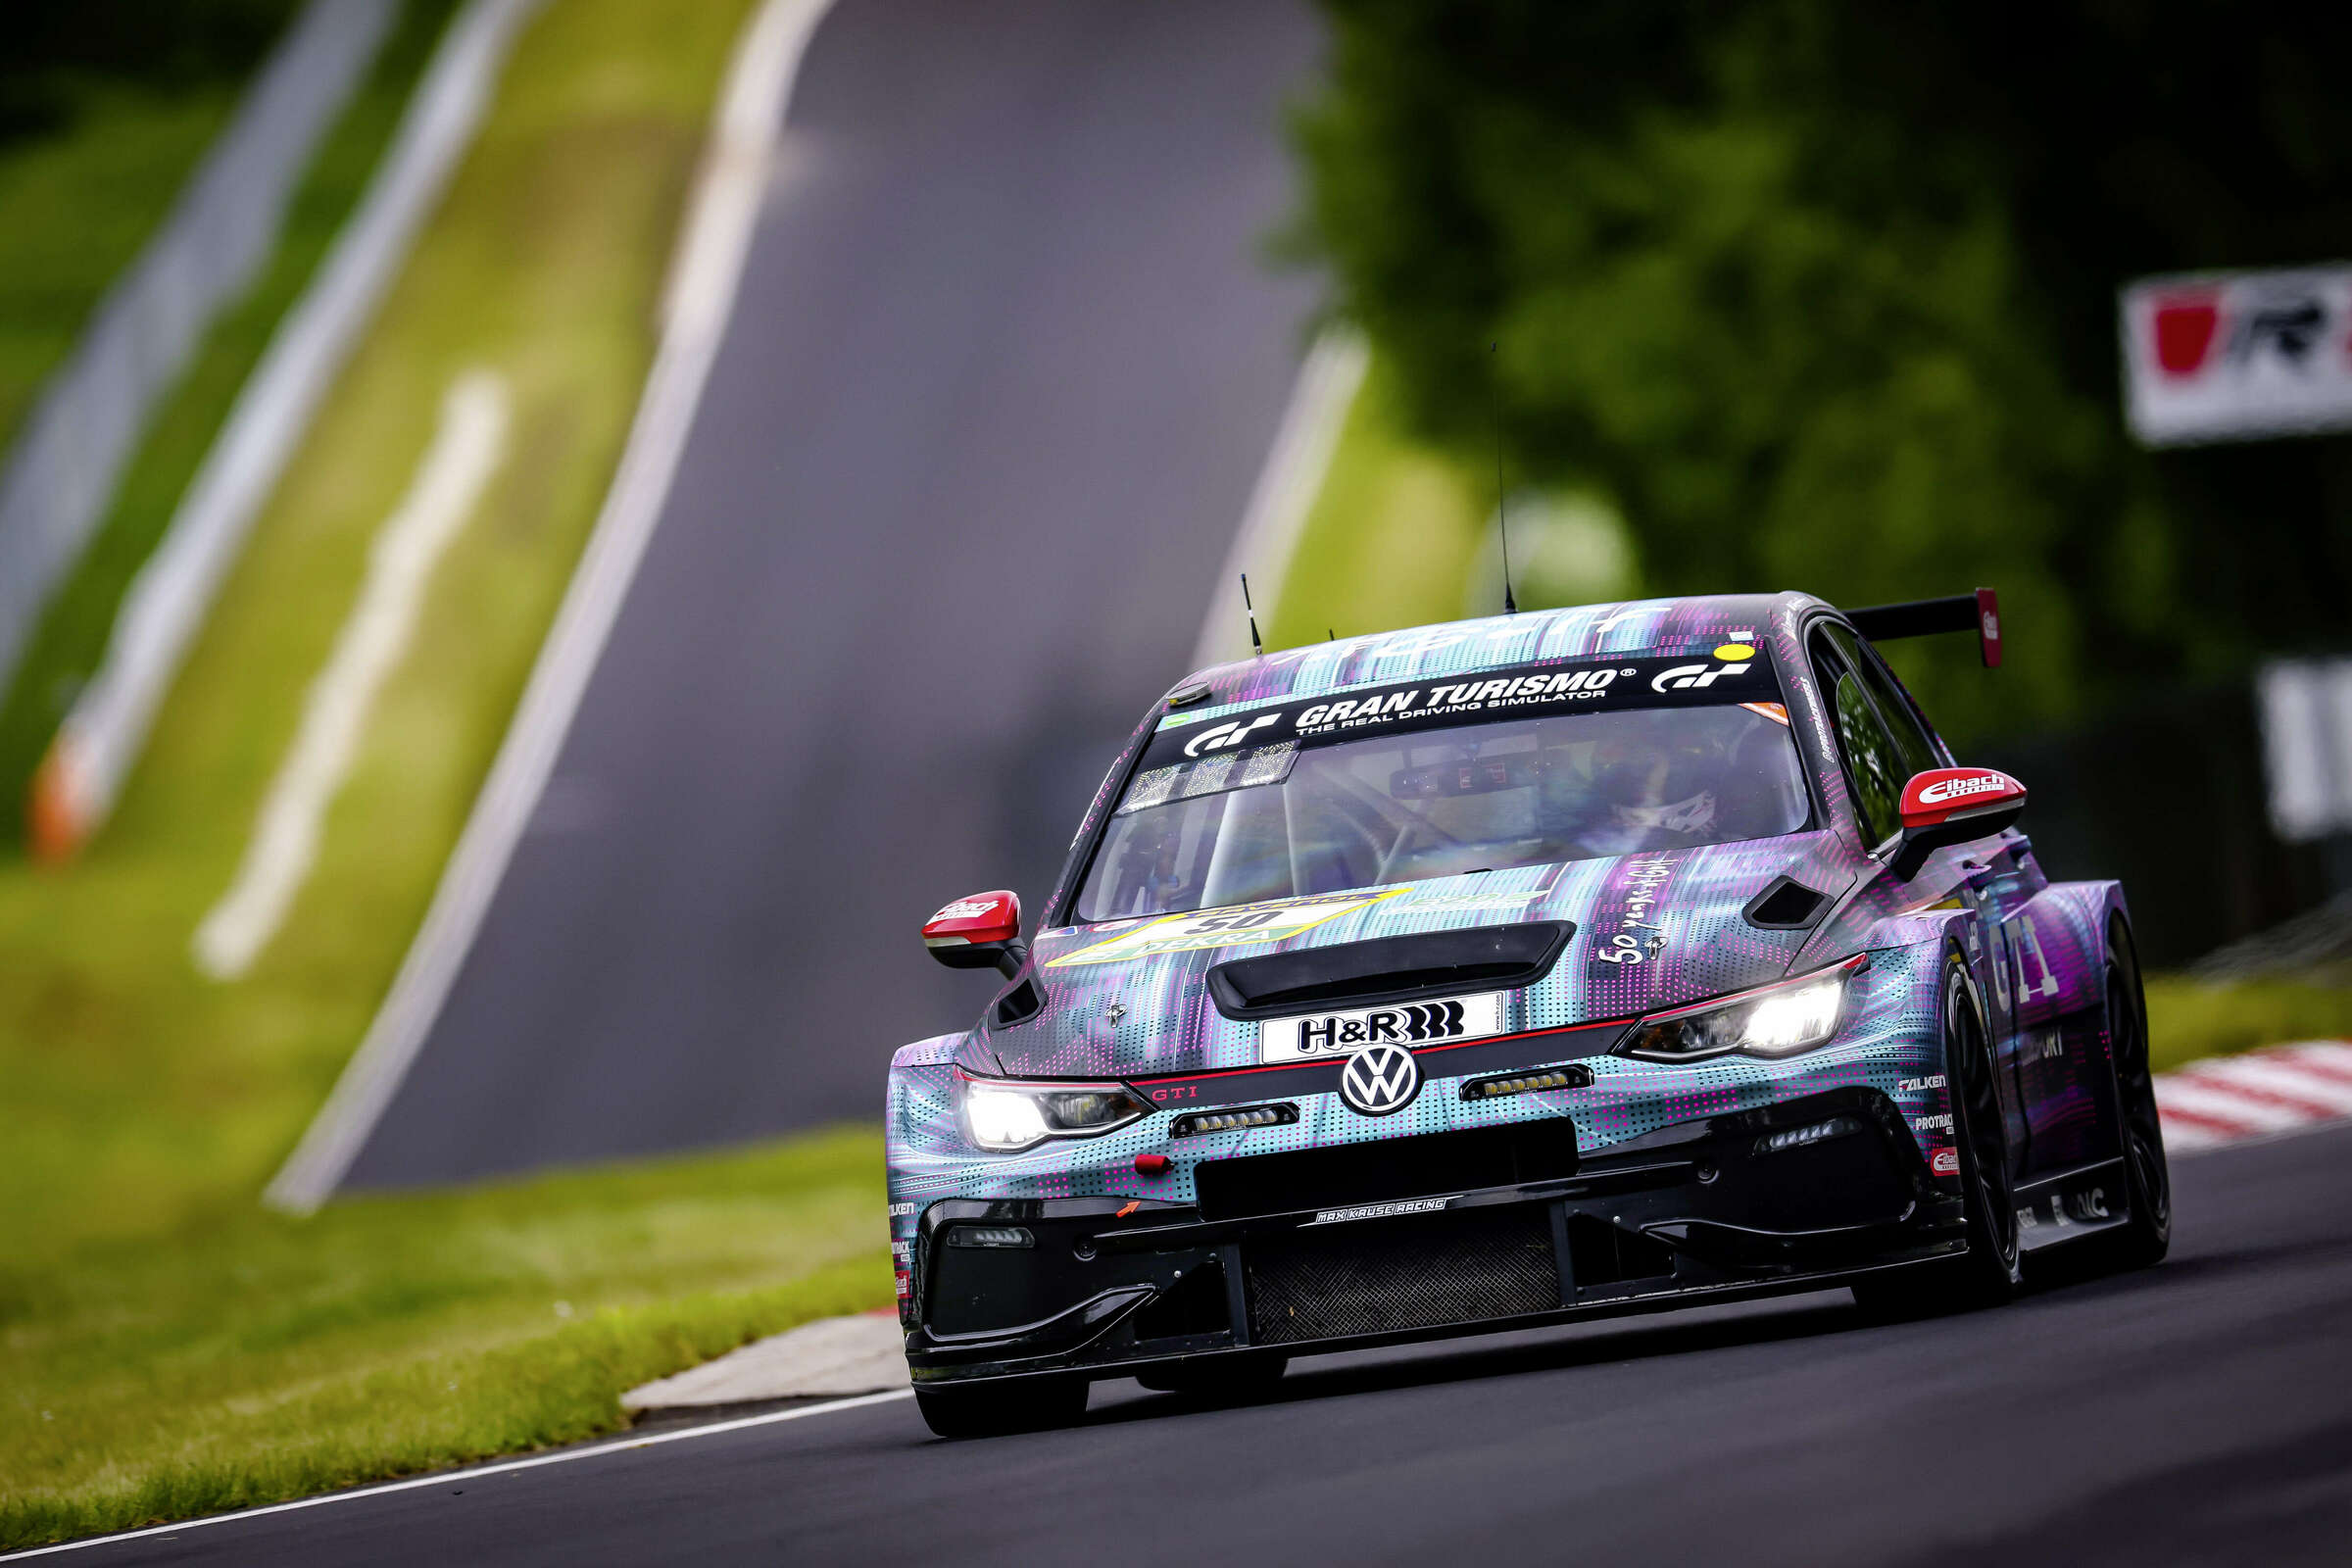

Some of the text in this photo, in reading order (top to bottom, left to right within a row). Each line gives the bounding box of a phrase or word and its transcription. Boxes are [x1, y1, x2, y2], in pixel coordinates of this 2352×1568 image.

[1296, 690, 1419, 728] GRAN
[1296, 689, 1607, 736] THE REAL DRIVING SIMULATOR
[1918, 773, 2005, 805] Eibach
[1627, 851, 1680, 878] Golf
[1181, 910, 1285, 935] 50
[1622, 889, 1663, 931] years
[1132, 929, 1271, 956] DEKRA
[1597, 934, 1644, 965] 50
[1299, 1010, 1400, 1051] H&R
[1344, 1044, 1416, 1112] VW
[1898, 1075, 1946, 1092] FALKEN
[1152, 1085, 1199, 1102] GTI
[1915, 1113, 1953, 1130] PROTRAC
[1316, 1209, 1347, 1224] MAX
[1395, 1199, 1447, 1215] RACING
